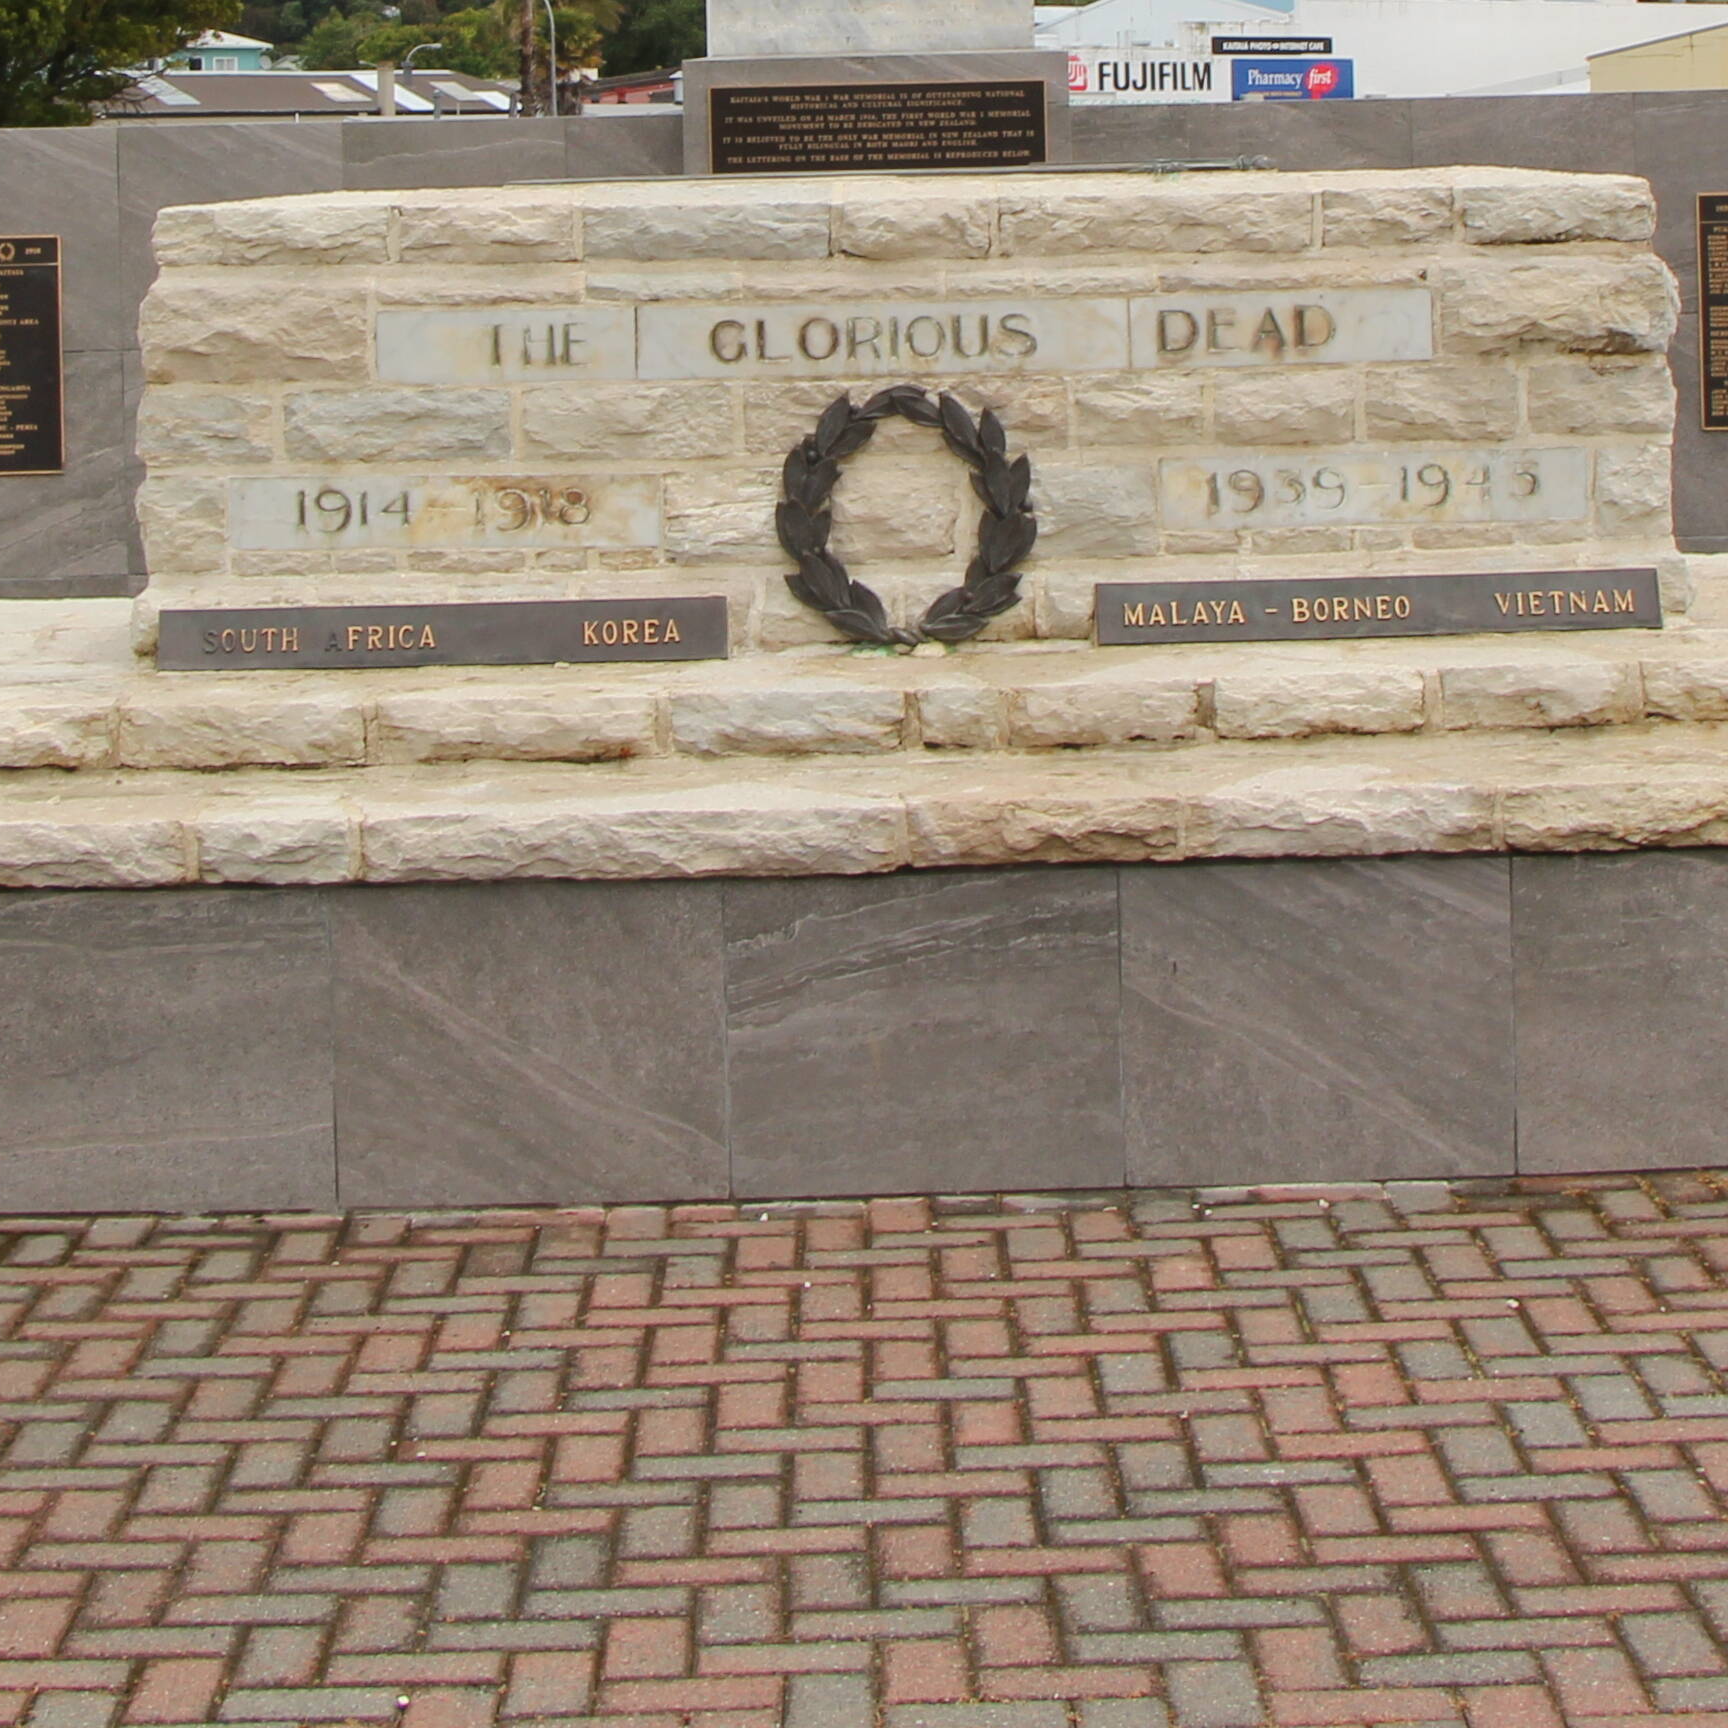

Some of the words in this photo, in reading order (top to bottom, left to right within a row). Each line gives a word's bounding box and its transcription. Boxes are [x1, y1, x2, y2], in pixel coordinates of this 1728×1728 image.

[1098, 61, 1212, 91] FUJIFILM
[1247, 69, 1303, 89] Pharmacy
[1308, 68, 1331, 90] first
[487, 322, 592, 367] THE
[708, 313, 1038, 364] GLORIOUS
[1156, 305, 1335, 354] DEAD
[1204, 468, 1346, 518] 1939
[1399, 461, 1539, 507] 1945
[296, 487, 412, 533] 1914
[474, 487, 591, 532] 1918
[1122, 600, 1246, 628] MALAYA
[1291, 594, 1411, 624] BORNEO
[1494, 588, 1635, 617] VIETNAM
[202, 627, 299, 654] SOUTH
[324, 624, 438, 653] AFRICA
[582, 618, 681, 647] KOREA
